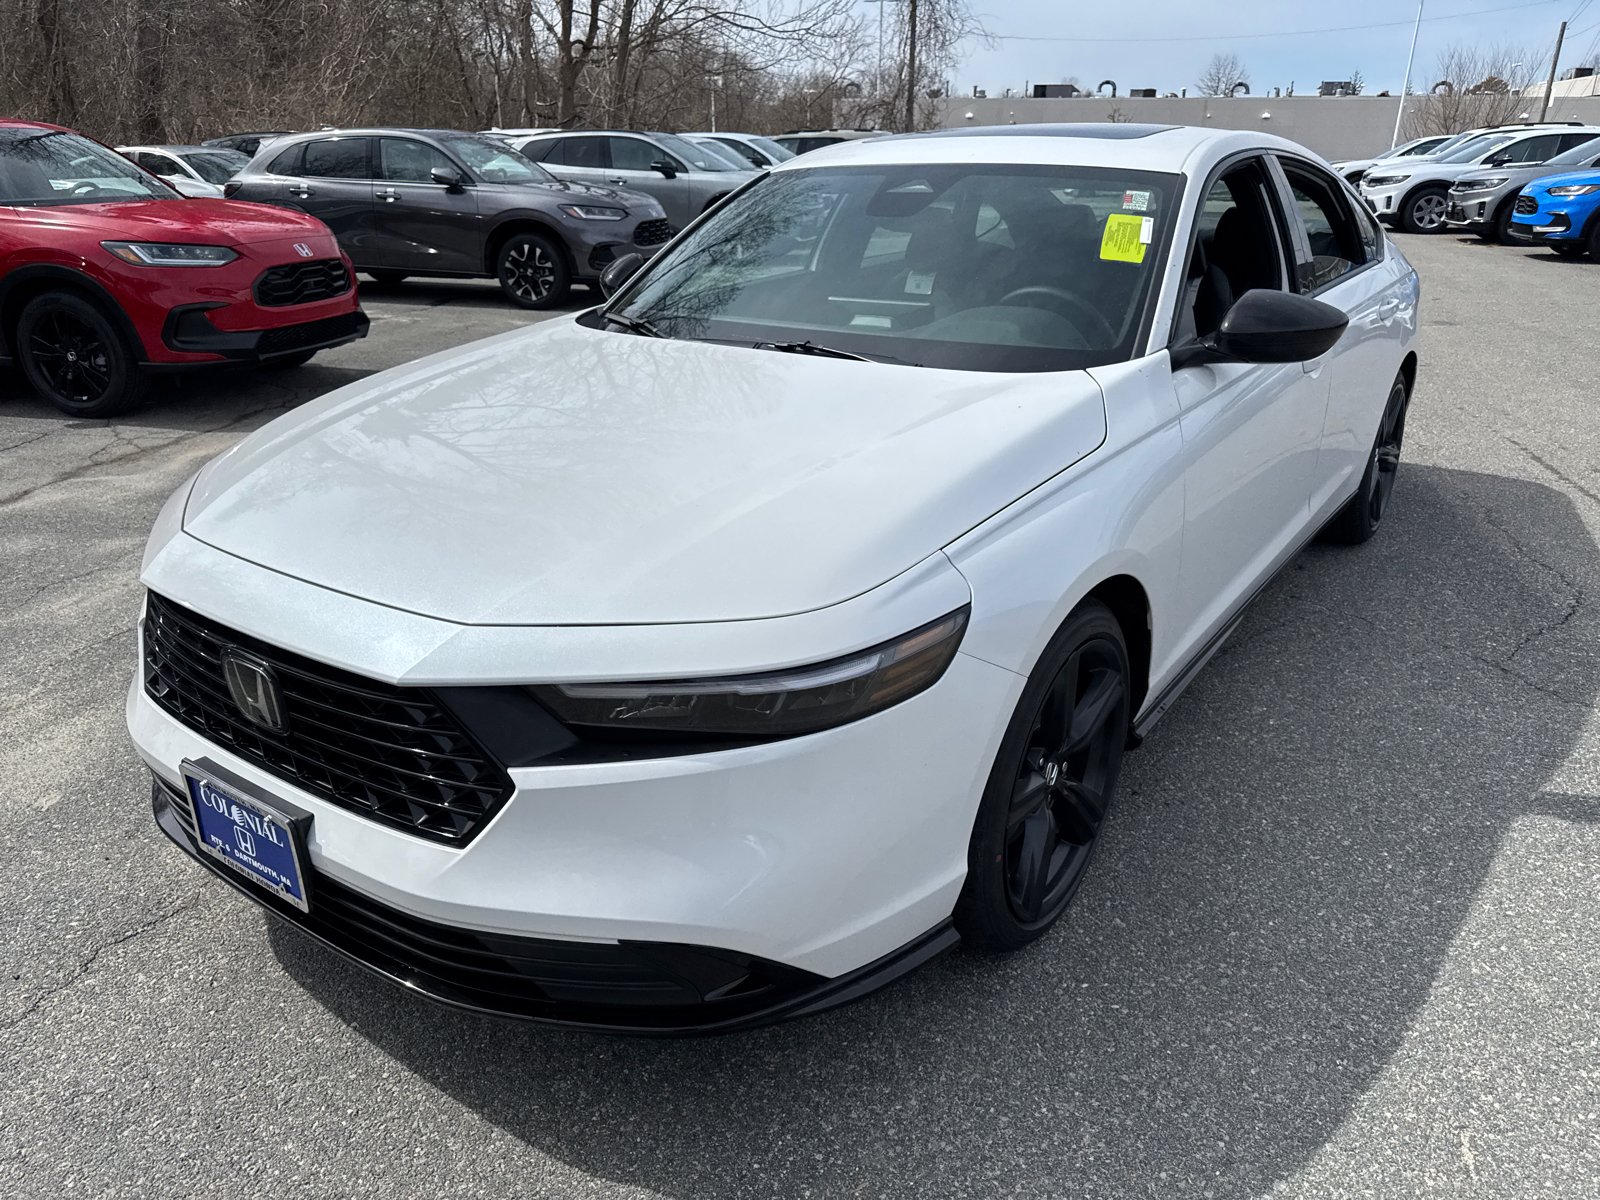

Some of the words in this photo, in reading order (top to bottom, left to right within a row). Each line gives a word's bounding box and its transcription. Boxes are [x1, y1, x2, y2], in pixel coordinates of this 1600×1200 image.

[200, 786, 284, 847] COLONIAL
[234, 849, 280, 880] DARTMOUTH,
[280, 874, 292, 887] MA
